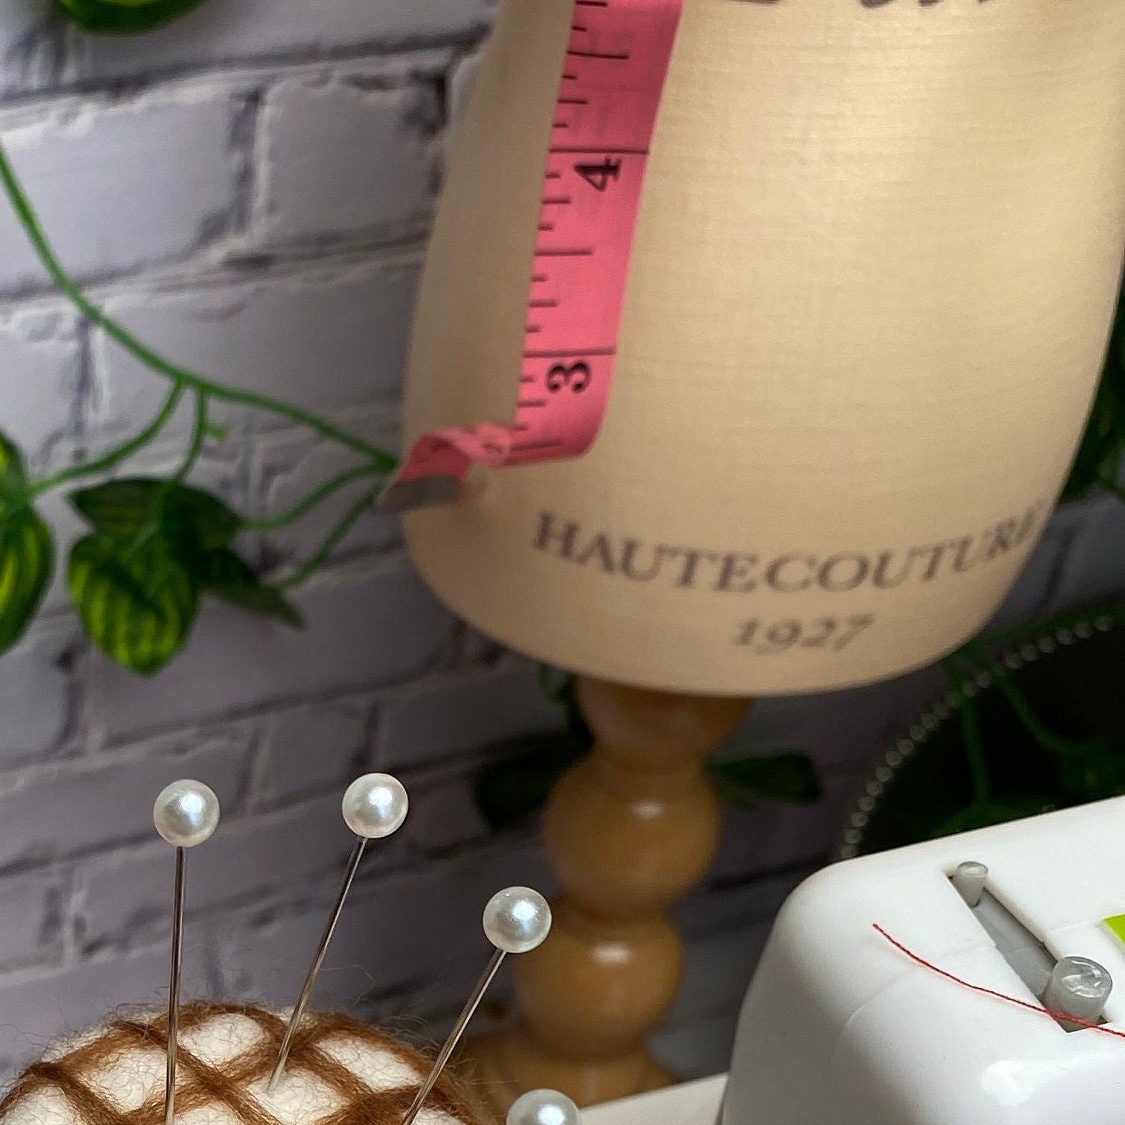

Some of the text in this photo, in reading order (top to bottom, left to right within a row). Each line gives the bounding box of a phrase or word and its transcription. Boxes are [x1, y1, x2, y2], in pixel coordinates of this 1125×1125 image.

[573, 157, 622, 192] 4
[545, 360, 592, 394] 3
[734, 614, 876, 655] 1927
